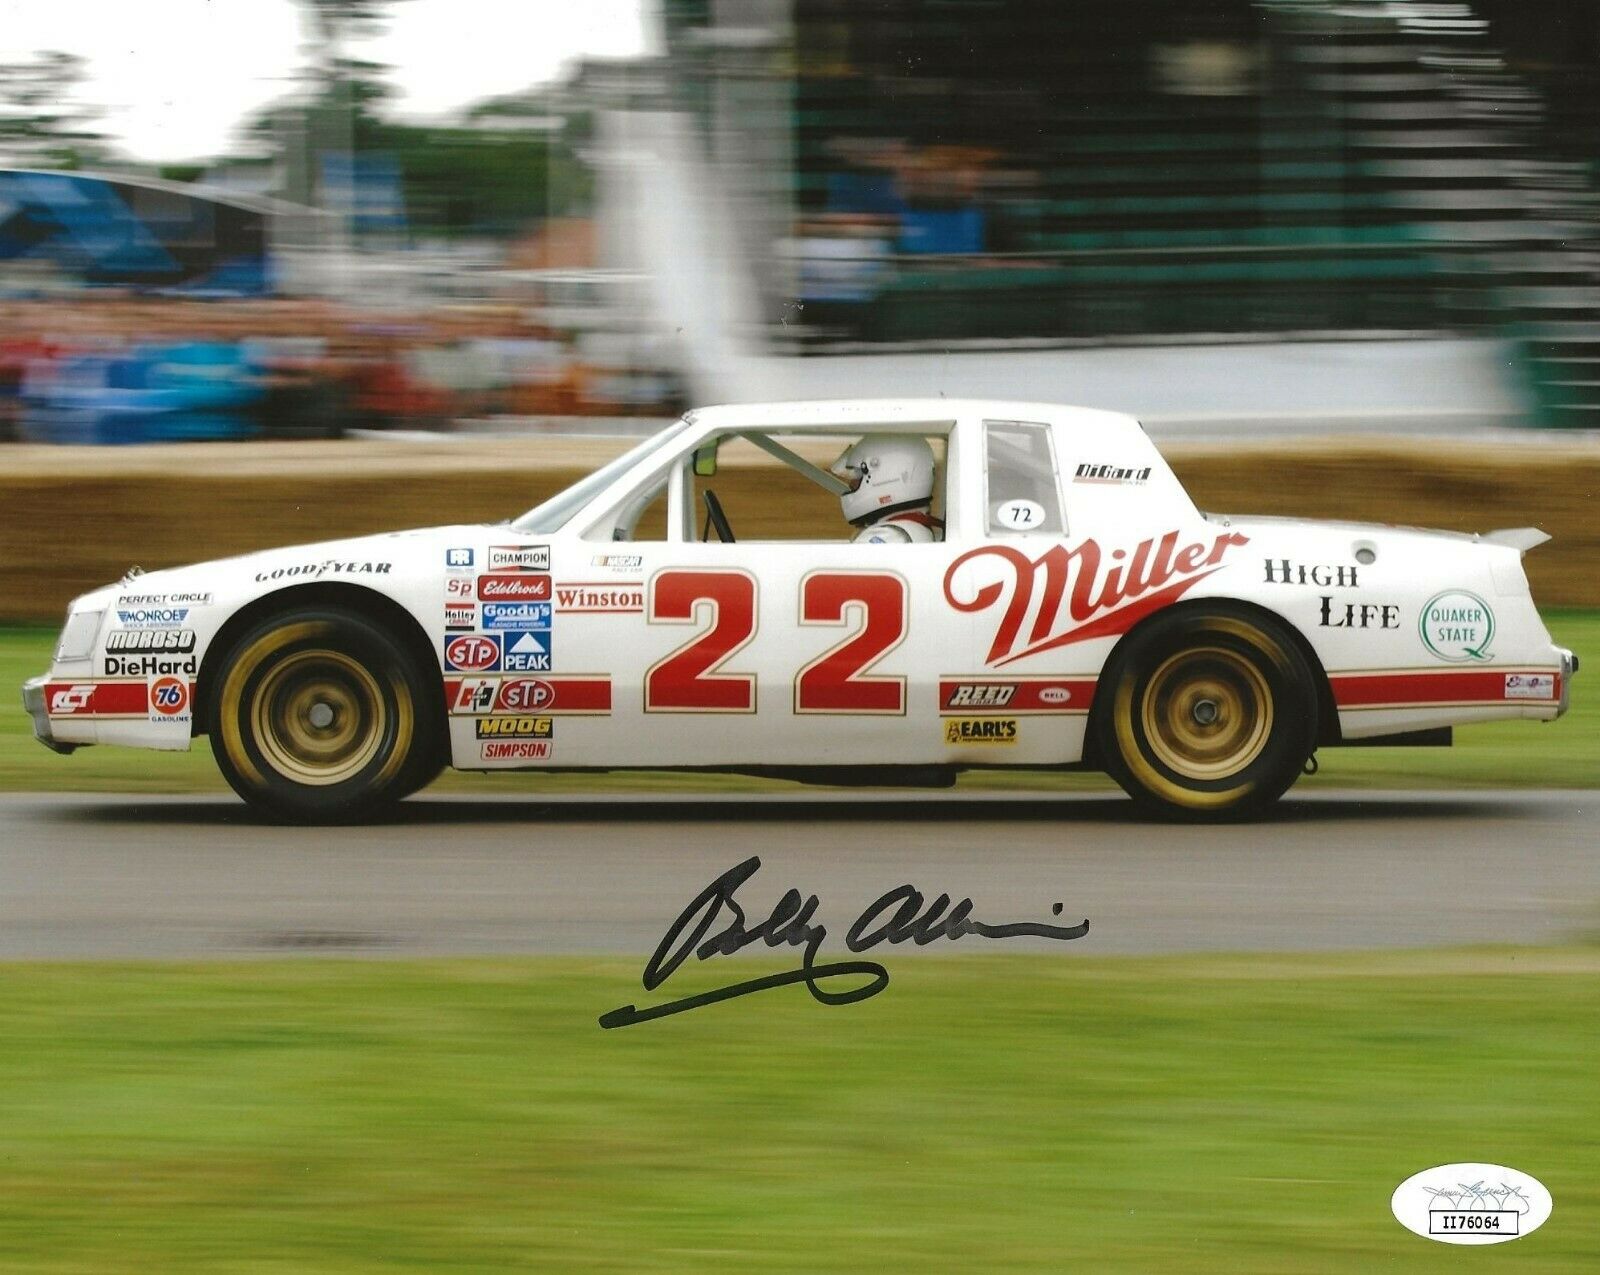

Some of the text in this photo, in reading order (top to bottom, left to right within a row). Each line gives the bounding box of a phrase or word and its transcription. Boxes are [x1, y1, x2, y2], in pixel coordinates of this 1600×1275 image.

[1011, 507, 1032, 522] 72
[493, 553, 547, 563] CHAMPION
[1263, 559, 1360, 588] HIGH
[483, 581, 544, 595] Edelbrock
[119, 592, 211, 604] PERFECT CIRCLE
[555, 589, 643, 607] Winston
[943, 530, 1250, 665] Miller
[125, 609, 180, 622] MONROE
[445, 610, 475, 620] Holley
[484, 604, 550, 621] Goody's
[1319, 596, 1400, 630] LIFE
[1431, 609, 1481, 623] QUAKER
[106, 630, 196, 654] MOROSO
[644, 566, 911, 716] 22
[1438, 628, 1475, 642] STATE
[453, 639, 492, 664] STP
[105, 656, 196, 675] DieHard
[505, 655, 549, 669] PEAK
[156, 685, 181, 704] 76
[507, 681, 547, 706] STP
[949, 685, 1016, 706] REED
[479, 719, 551, 733] MOOG
[961, 721, 1016, 737] EARL'S
[486, 743, 547, 757] SIMPSON
[1443, 1216, 1500, 1229] II76064
